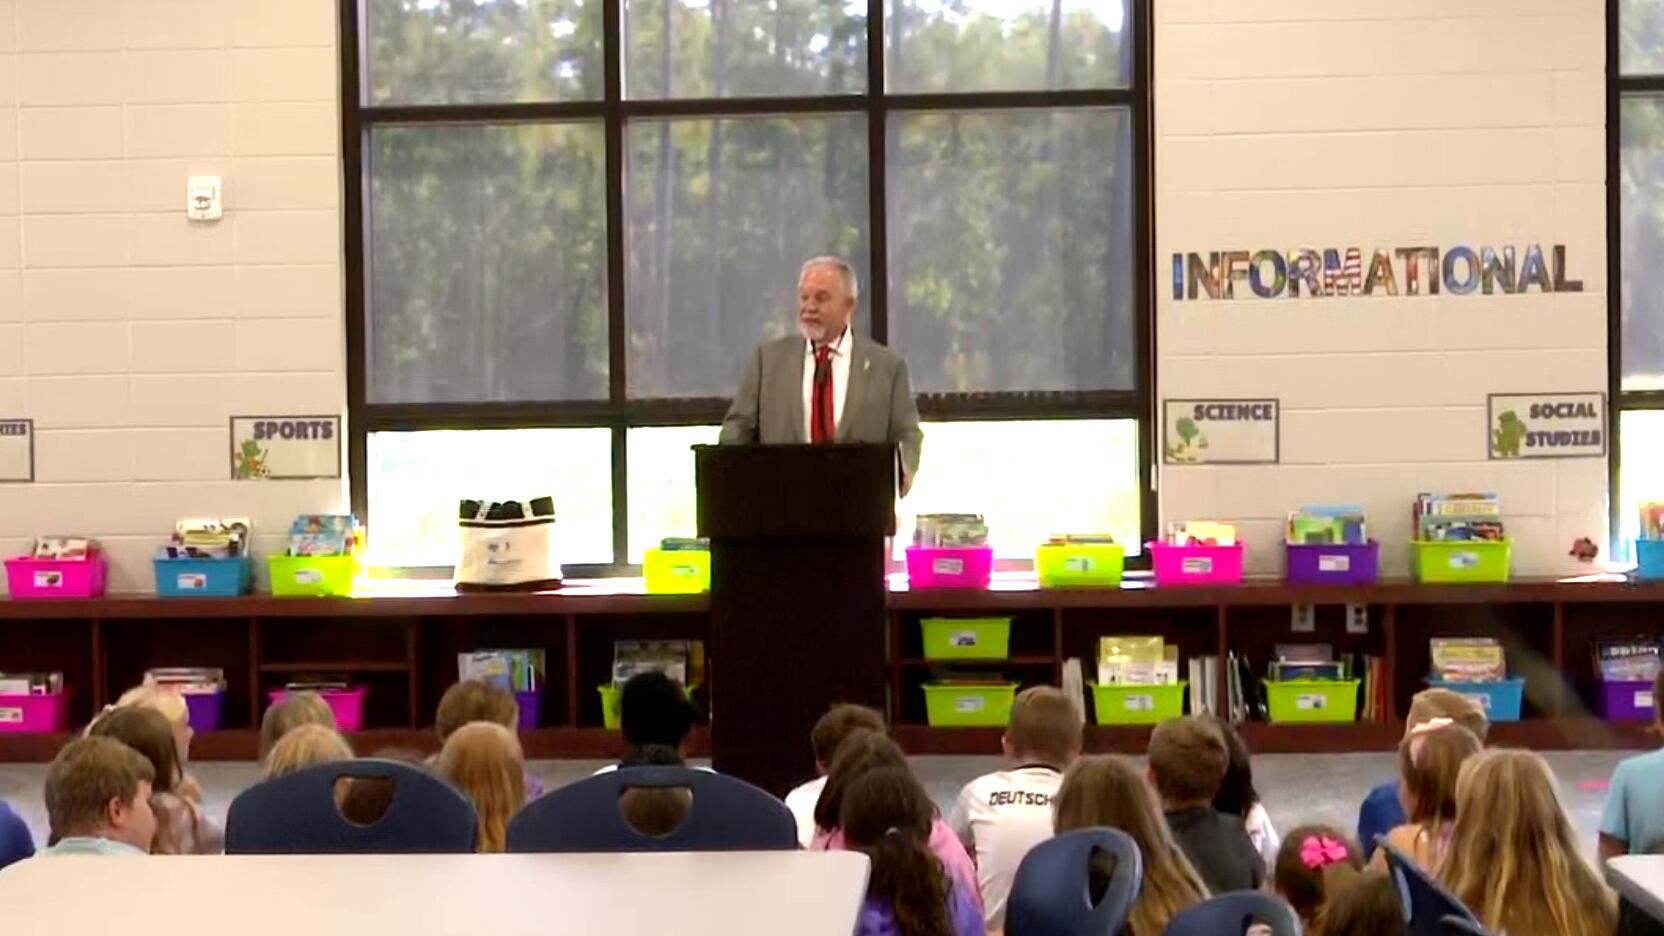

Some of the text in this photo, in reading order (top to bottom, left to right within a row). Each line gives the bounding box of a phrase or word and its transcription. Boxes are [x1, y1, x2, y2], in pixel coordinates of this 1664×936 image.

[1172, 245, 1583, 300] INFORMATIONAL
[1193, 404, 1273, 421] SCIENCE
[1529, 402, 1597, 419] SOCIAL
[253, 421, 334, 440] SPORTS
[1525, 430, 1601, 447] STUDIES
